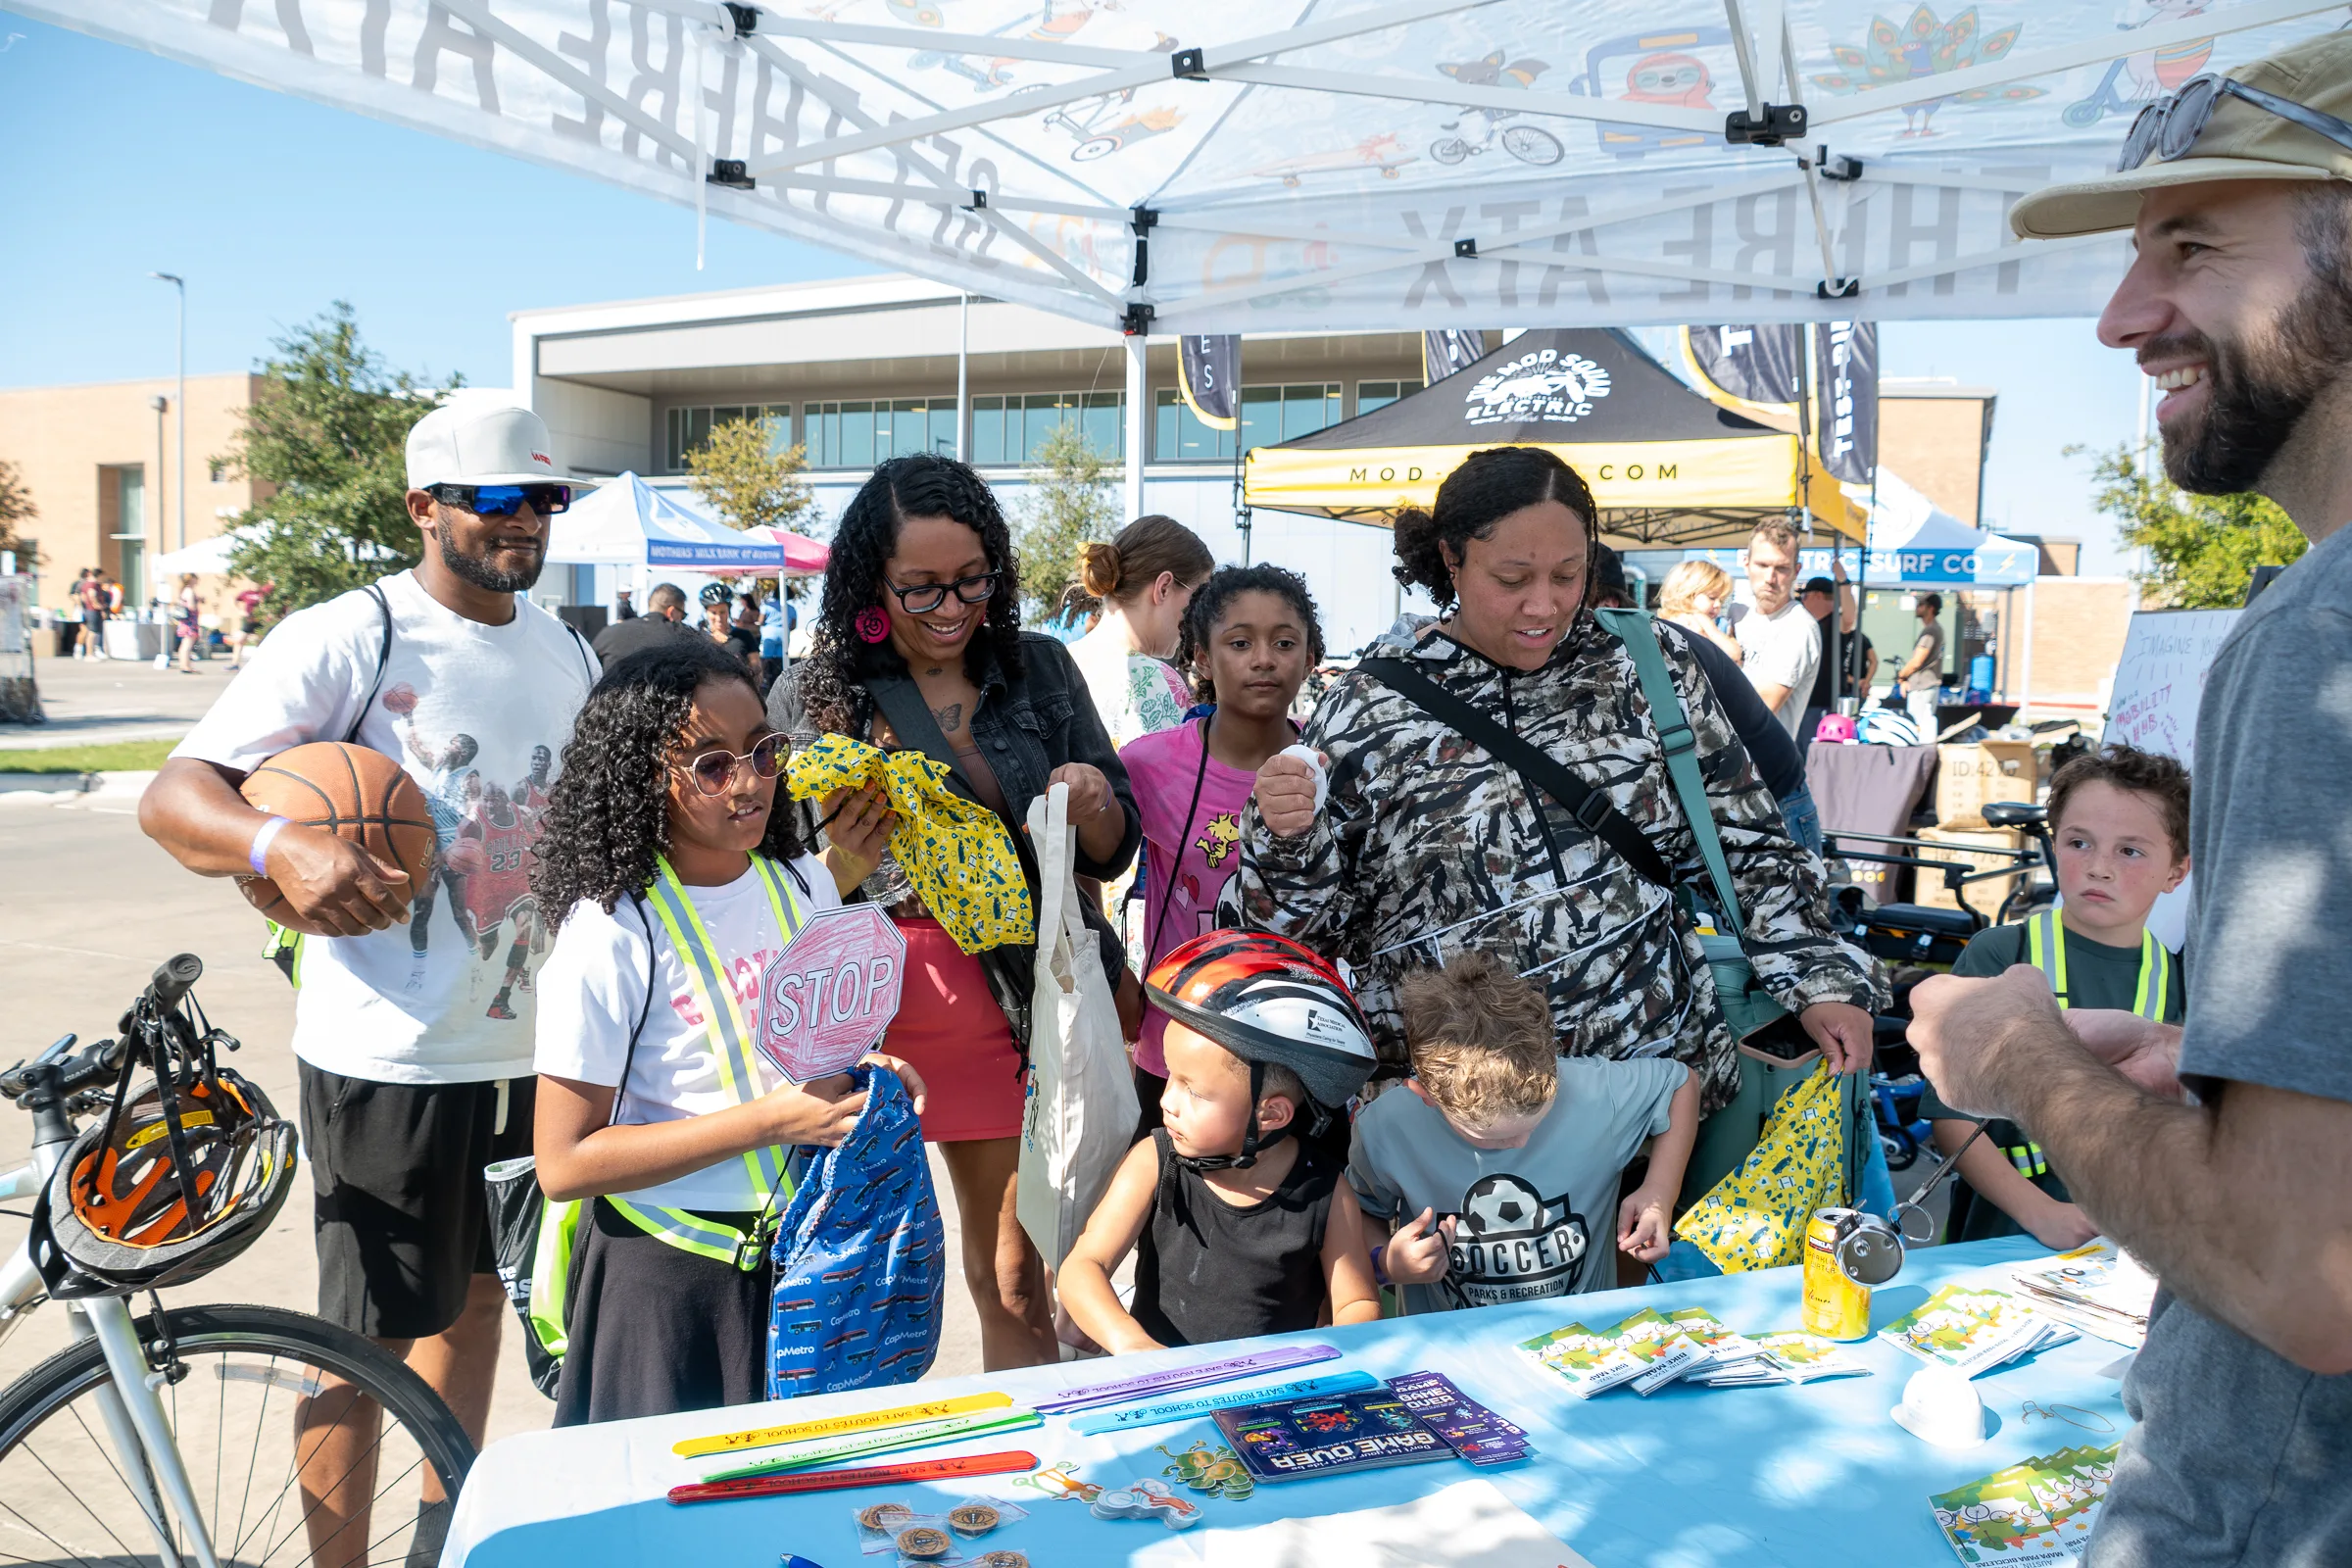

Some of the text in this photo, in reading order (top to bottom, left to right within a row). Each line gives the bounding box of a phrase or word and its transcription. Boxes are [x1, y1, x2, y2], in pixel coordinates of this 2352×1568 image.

[1496, 348, 1558, 376] MOD
[1464, 400, 1593, 419] ELECTRIC
[1867, 552, 1936, 573] SURF
[1943, 553, 1984, 574] CO
[490, 849, 521, 872] 23
[769, 955, 894, 1036] STOP
[64, 1064, 94, 1082] GIANT
[1450, 1229, 1574, 1275] SOCCER
[1469, 1279, 1564, 1299] PARKS & RECREATION
[884, 1328, 928, 1347] CapMetro
[1666, 1351, 1688, 1369] BIKE
[1212, 1393, 1254, 1405] ROUTES
[1256, 1387, 1284, 1397] SAFE
[1151, 1403, 1195, 1415] SCHOOL
[1405, 1395, 1455, 1409] OVER
[763, 1411, 912, 1438] SAFE ROUTES TO SCHOOL
[1270, 1432, 1437, 1468] GAME OVER
[840, 1470, 890, 1481] ROUTES
[894, 1465, 925, 1475] SAFE
[766, 1476, 816, 1487] SCHOOL
[1975, 1551, 2064, 1568] MAPA PARA BICICLETAS
